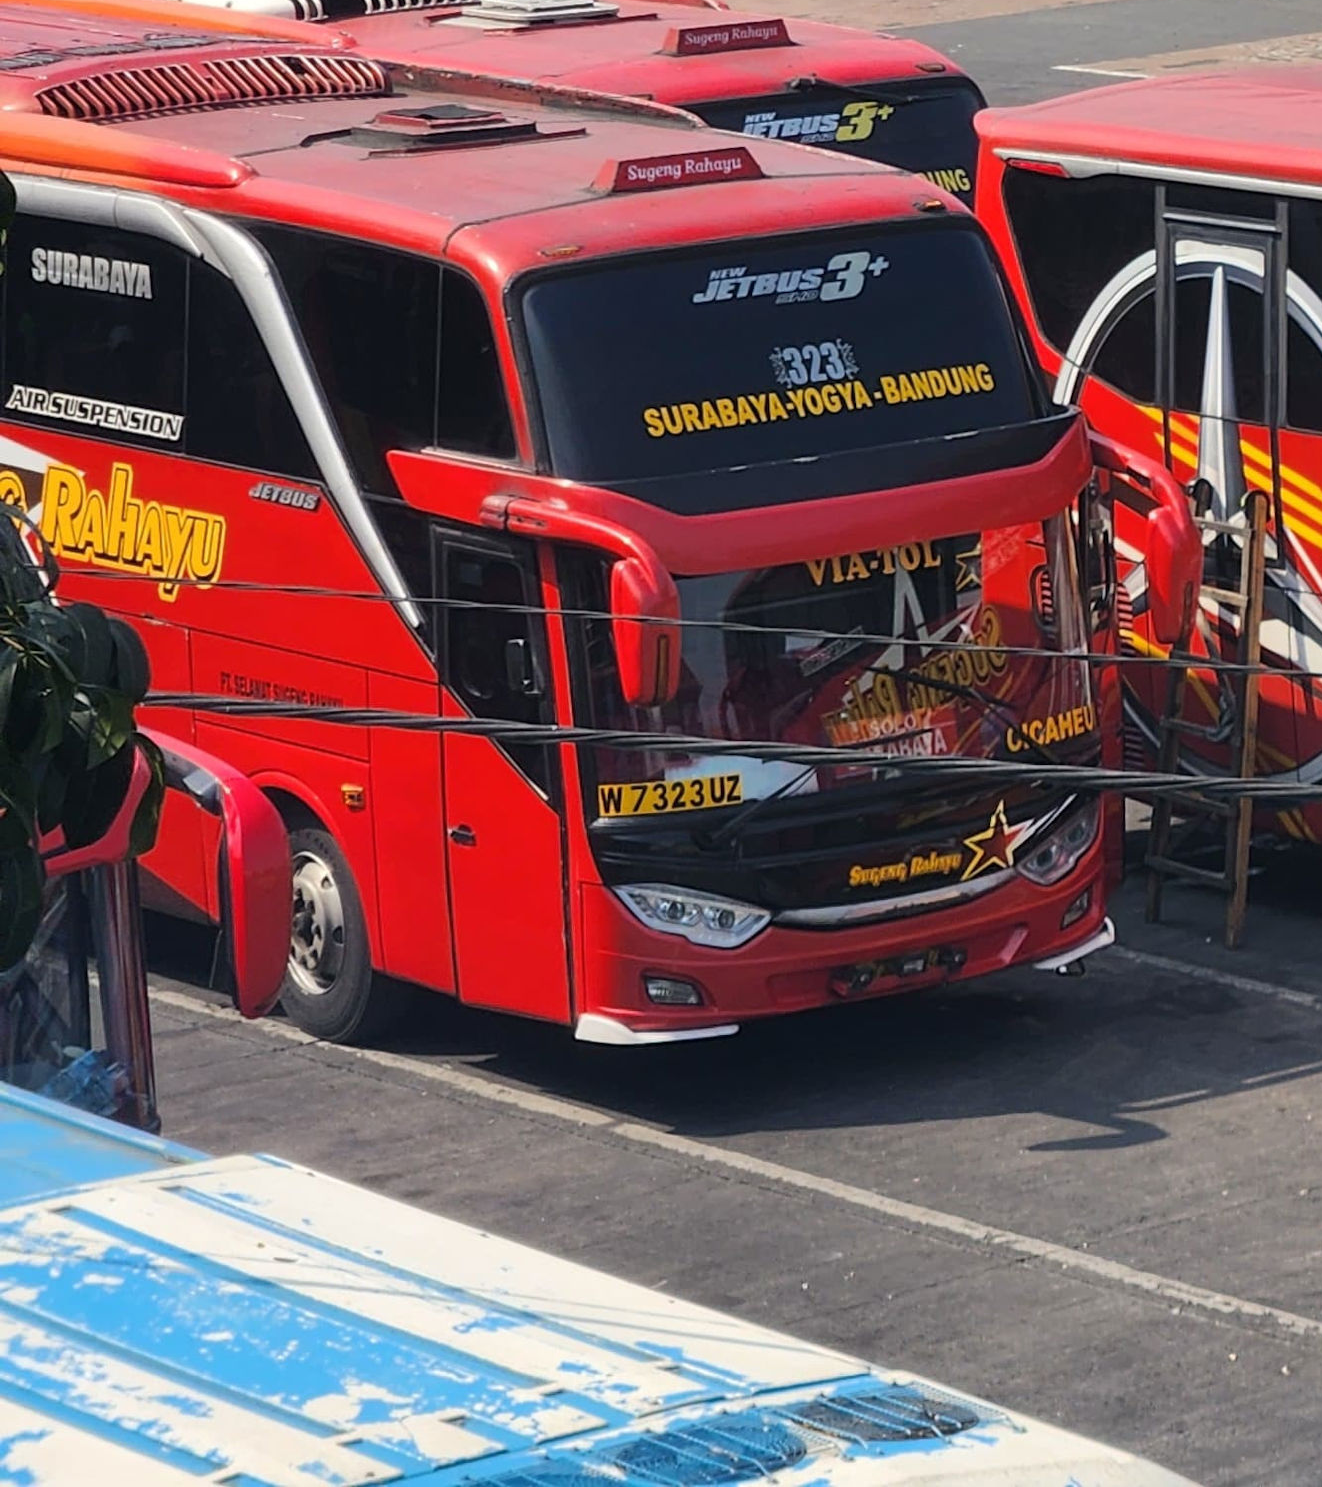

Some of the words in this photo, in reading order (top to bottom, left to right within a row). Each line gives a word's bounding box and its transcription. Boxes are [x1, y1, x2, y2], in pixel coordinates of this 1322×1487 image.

[684, 29, 731, 49] Sugeng
[731, 23, 779, 43] Rahayu
[626, 161, 683, 182] Sugeng
[684, 155, 743, 177] Rahayu
[31, 247, 154, 301] SURABAYA
[692, 268, 825, 304] JETBUS
[709, 266, 748, 279] NEW
[782, 342, 842, 384] 323
[6, 384, 50, 415] AIR
[50, 392, 184, 441] SUSPENSION
[248, 481, 321, 512] JETBUS
[37, 460, 226, 602] RAHAYU
[805, 540, 942, 588] VIA-TOL
[234, 673, 271, 700] SELAMAT
[600, 788, 622, 814] W
[631, 780, 705, 813] 7323
[710, 775, 742, 803] UZ
